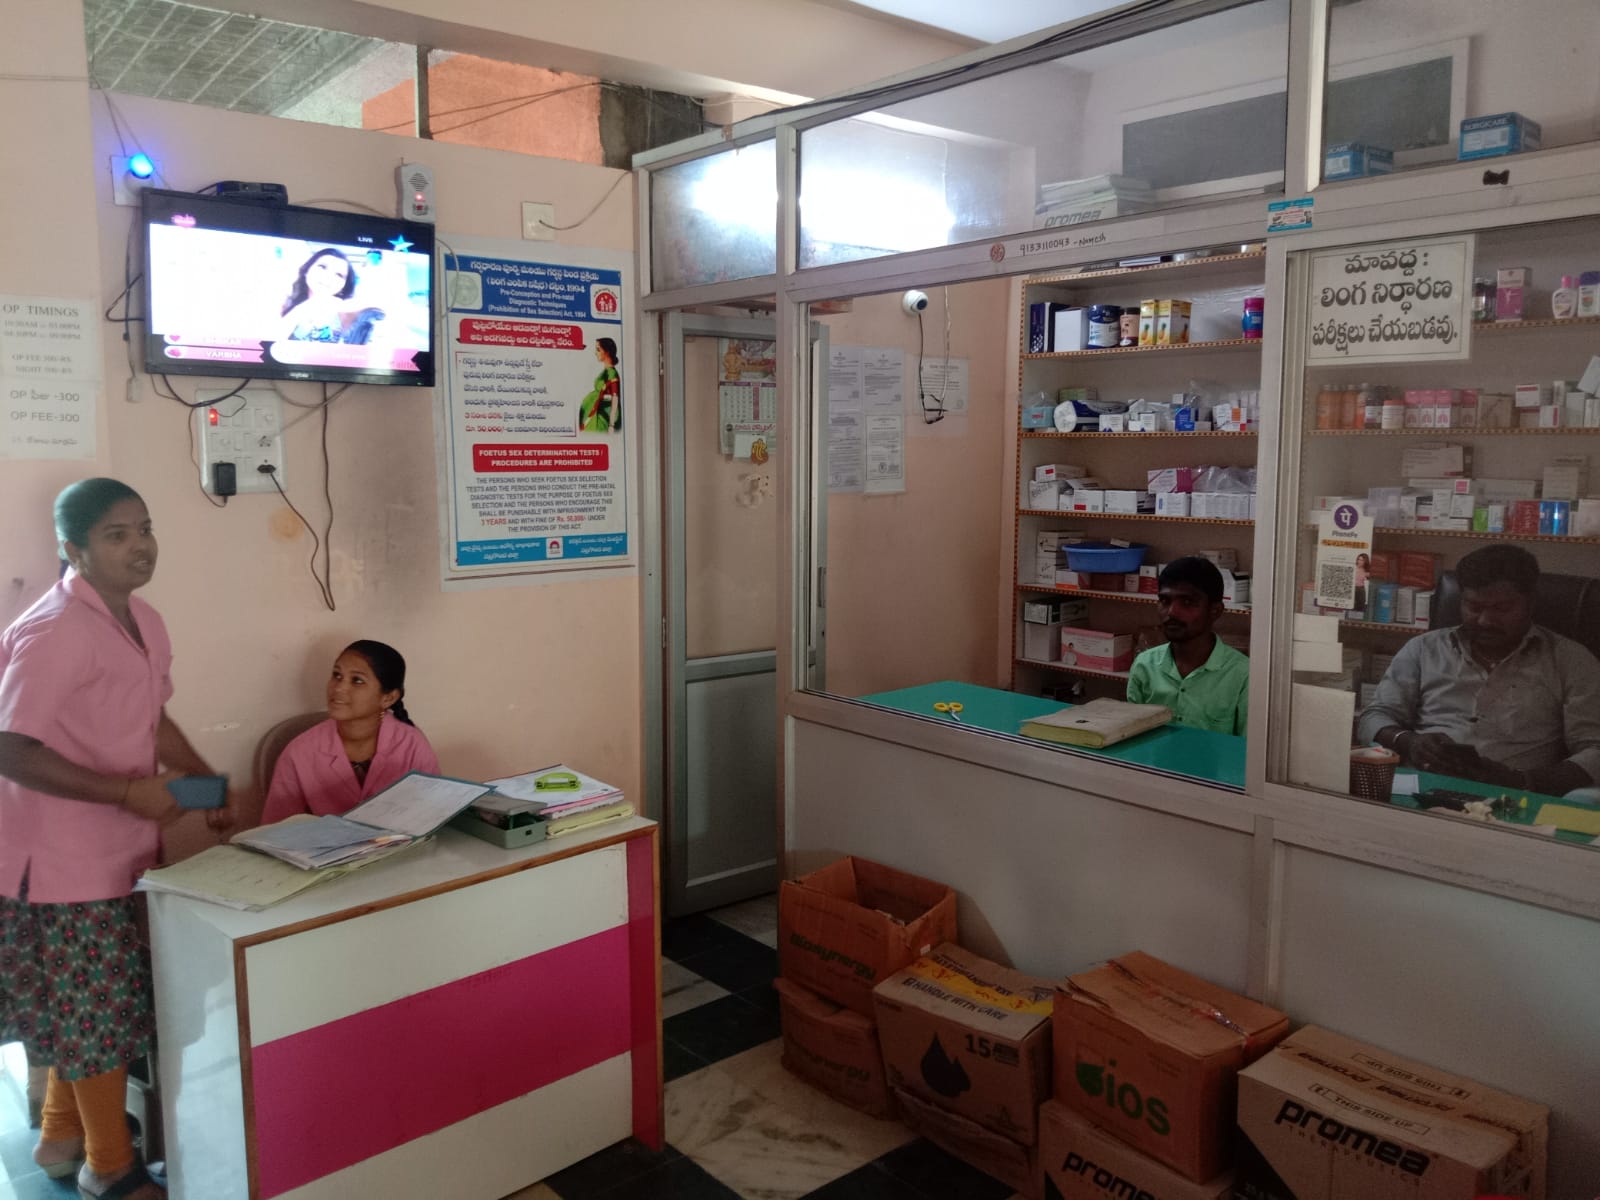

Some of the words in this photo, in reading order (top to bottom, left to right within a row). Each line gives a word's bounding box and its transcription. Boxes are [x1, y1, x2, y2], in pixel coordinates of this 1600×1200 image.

[1345, 250, 1417, 276] మావద్ద
[509, 298, 537, 306] Diagnostic
[1320, 281, 1367, 307] లింగ
[1372, 277, 1453, 314] నిర్ధారణ
[2, 304, 20, 313] OP
[27, 305, 80, 317] TIMINGS
[1312, 319, 1365, 355] పరీక్షలు
[10, 390, 27, 399] OP
[10, 410, 27, 420] OP
[912, 981, 953, 999] HANDLE
[1274, 1099, 1430, 1176] promea
